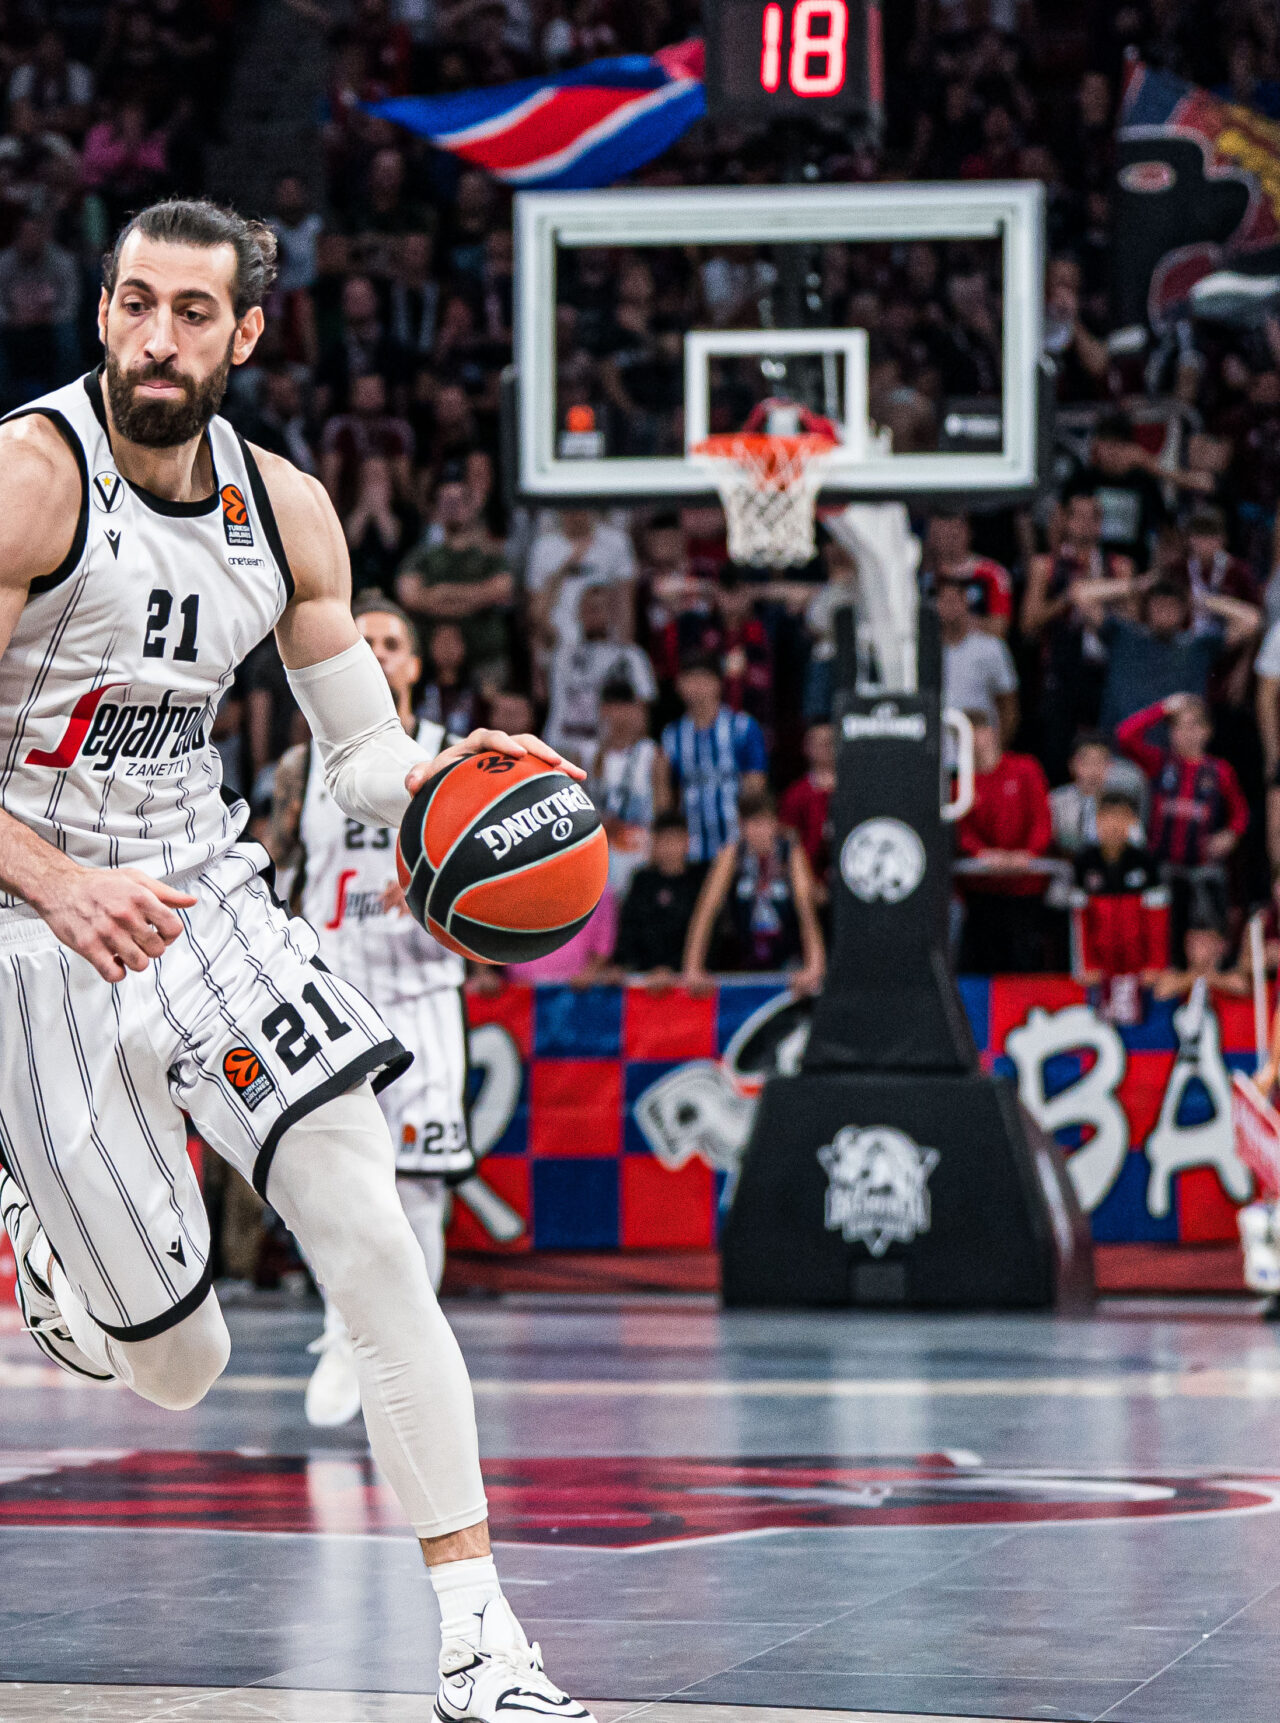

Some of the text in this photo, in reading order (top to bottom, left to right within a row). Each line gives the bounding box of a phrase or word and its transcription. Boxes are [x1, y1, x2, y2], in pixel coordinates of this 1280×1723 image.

[760, 0, 848, 97] 18
[143, 589, 200, 662] 21
[125, 758, 185, 777] ZANETTI
[261, 982, 352, 1075] 21
